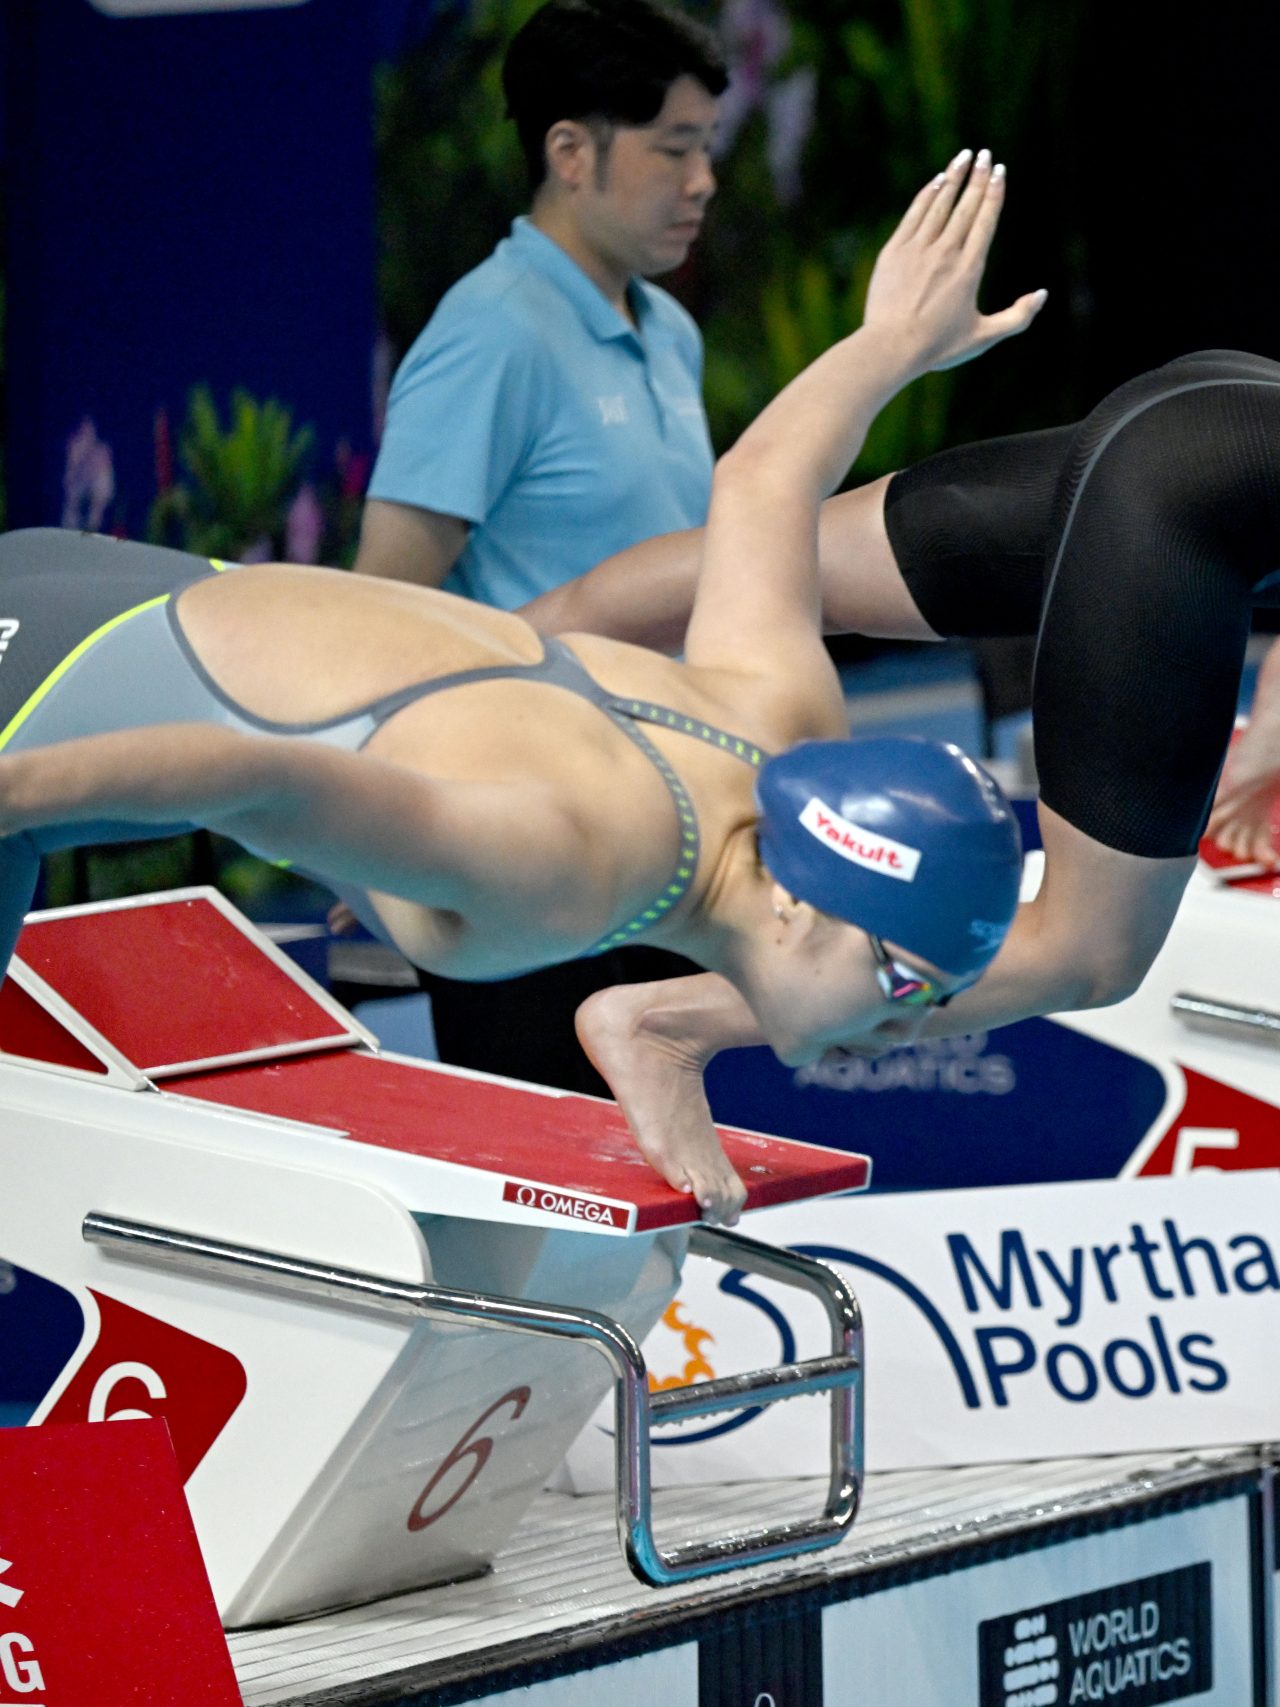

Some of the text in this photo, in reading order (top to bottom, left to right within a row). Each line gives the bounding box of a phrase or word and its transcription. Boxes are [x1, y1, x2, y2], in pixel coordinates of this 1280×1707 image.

[816, 811, 904, 869] Yakult
[540, 1193, 615, 1226] OMEGA
[974, 1314, 1230, 1410] Pools
[406, 1384, 532, 1533] 6
[1068, 1600, 1160, 1657] WORLD
[1068, 1637, 1192, 1706] AQUATICS
